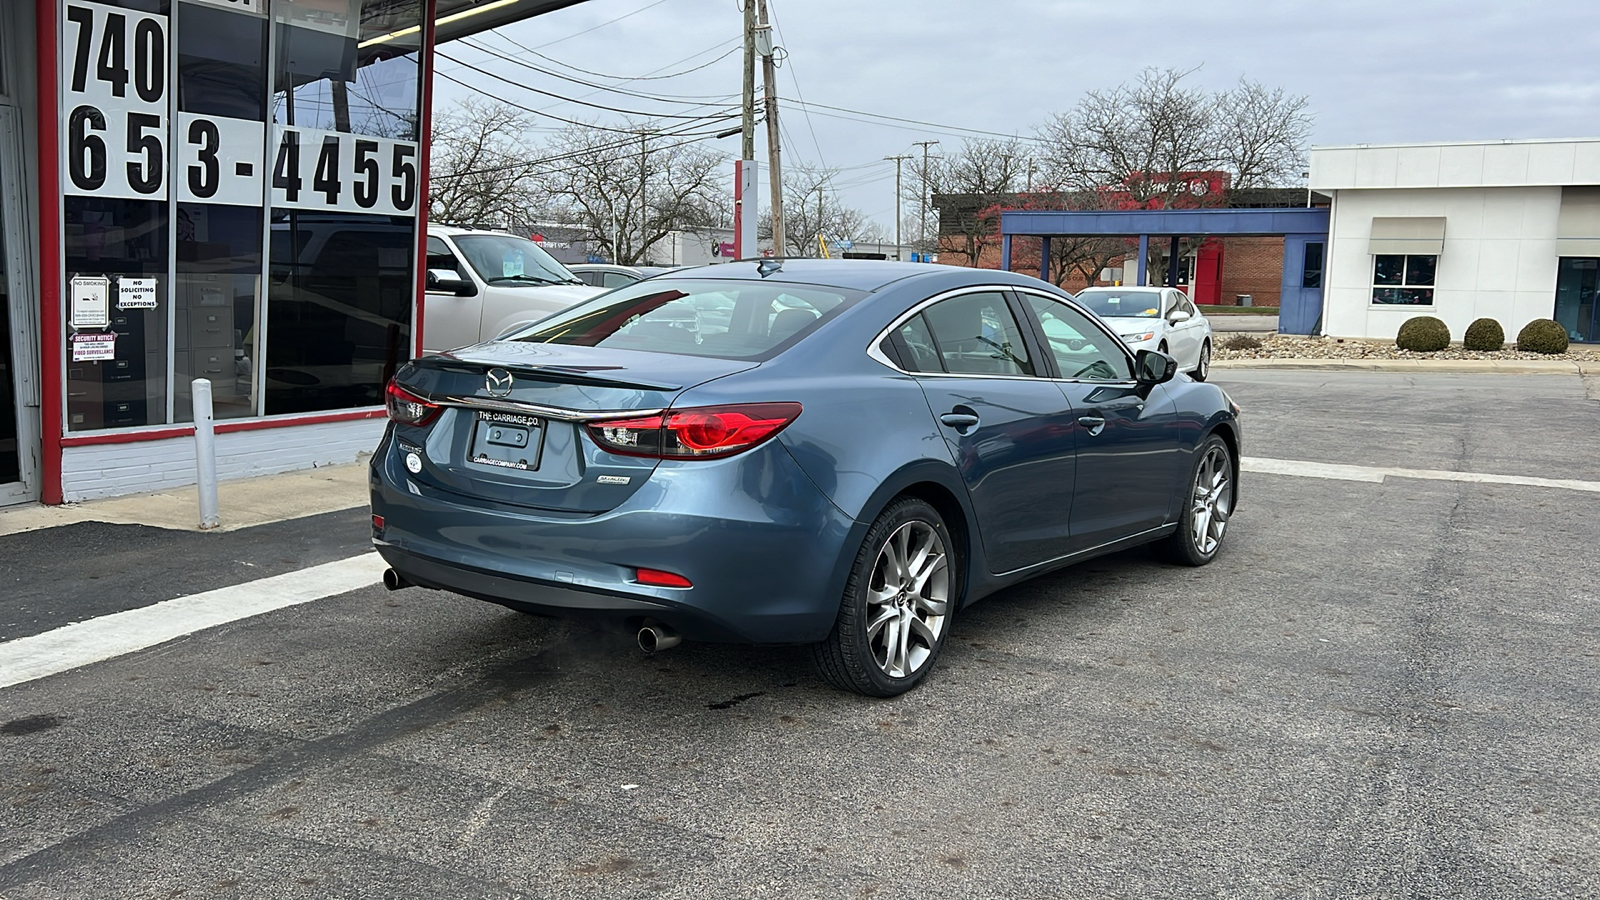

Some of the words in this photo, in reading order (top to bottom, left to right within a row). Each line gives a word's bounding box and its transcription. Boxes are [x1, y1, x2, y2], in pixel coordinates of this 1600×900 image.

[67, 5, 165, 103] 740
[479, 411, 492, 420] THE
[493, 413, 527, 424] CARRIAGE
[473, 457, 527, 469] CARRIAGECOMPANY.COM
